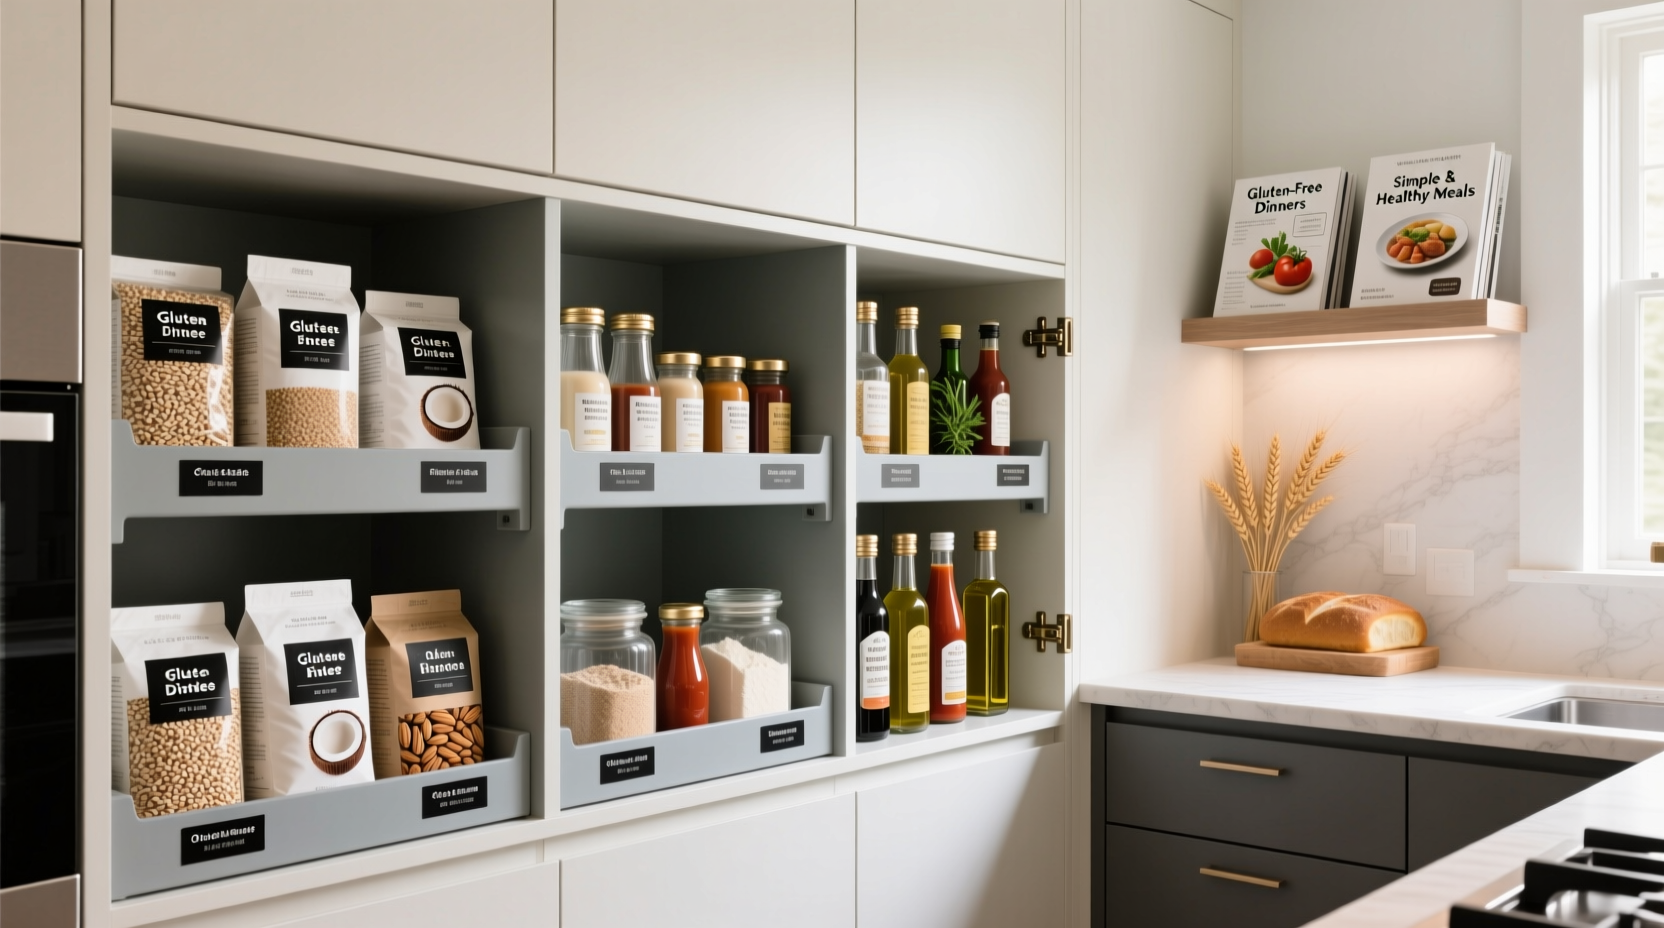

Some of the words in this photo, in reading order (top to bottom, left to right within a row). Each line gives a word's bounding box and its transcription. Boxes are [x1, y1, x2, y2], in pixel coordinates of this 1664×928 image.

[1393, 172, 1441, 189] Simple
[1445, 170, 1456, 183] &
[1376, 189, 1431, 205] Healthy
[1433, 183, 1476, 200] Meals
[1254, 200, 1306, 214] Dinners
[156, 310, 207, 326] Gluten
